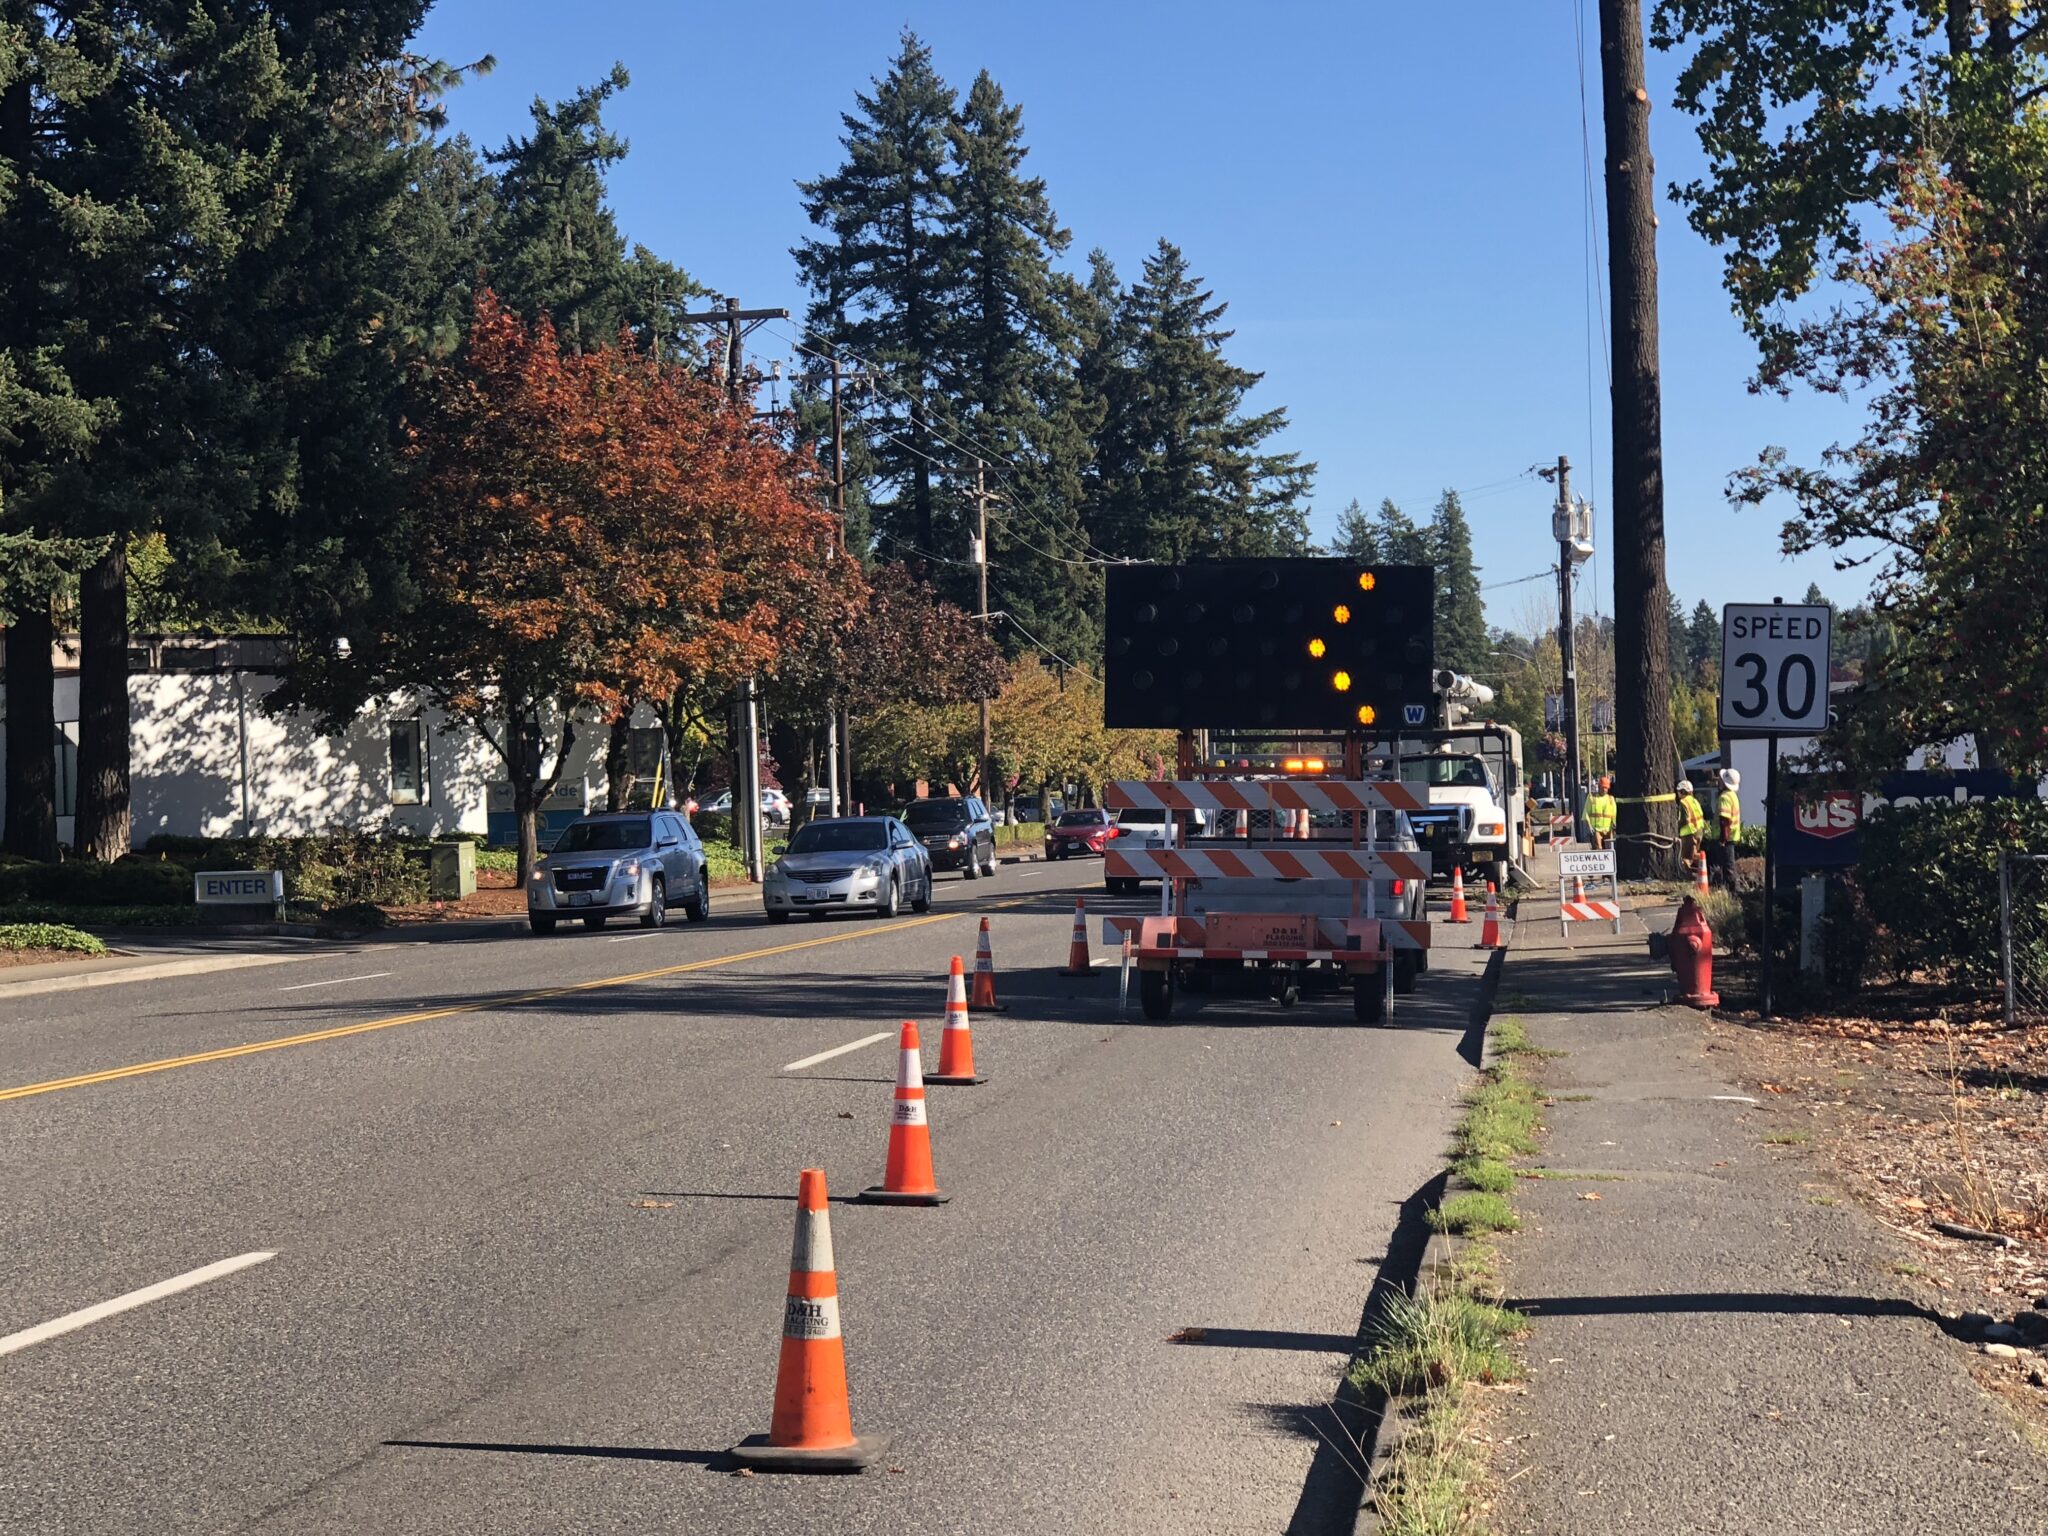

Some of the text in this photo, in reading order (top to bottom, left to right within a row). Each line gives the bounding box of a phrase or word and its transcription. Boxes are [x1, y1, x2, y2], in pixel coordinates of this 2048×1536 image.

[1732, 615, 1822, 640] SPEED
[1731, 652, 1817, 720] 30
[1404, 705, 1425, 724] W
[1564, 853, 1610, 862] SIDEWALK
[1569, 863, 1606, 872] CLOSED
[207, 879, 266, 895] ENTER
[787, 1303, 822, 1317] D&H
